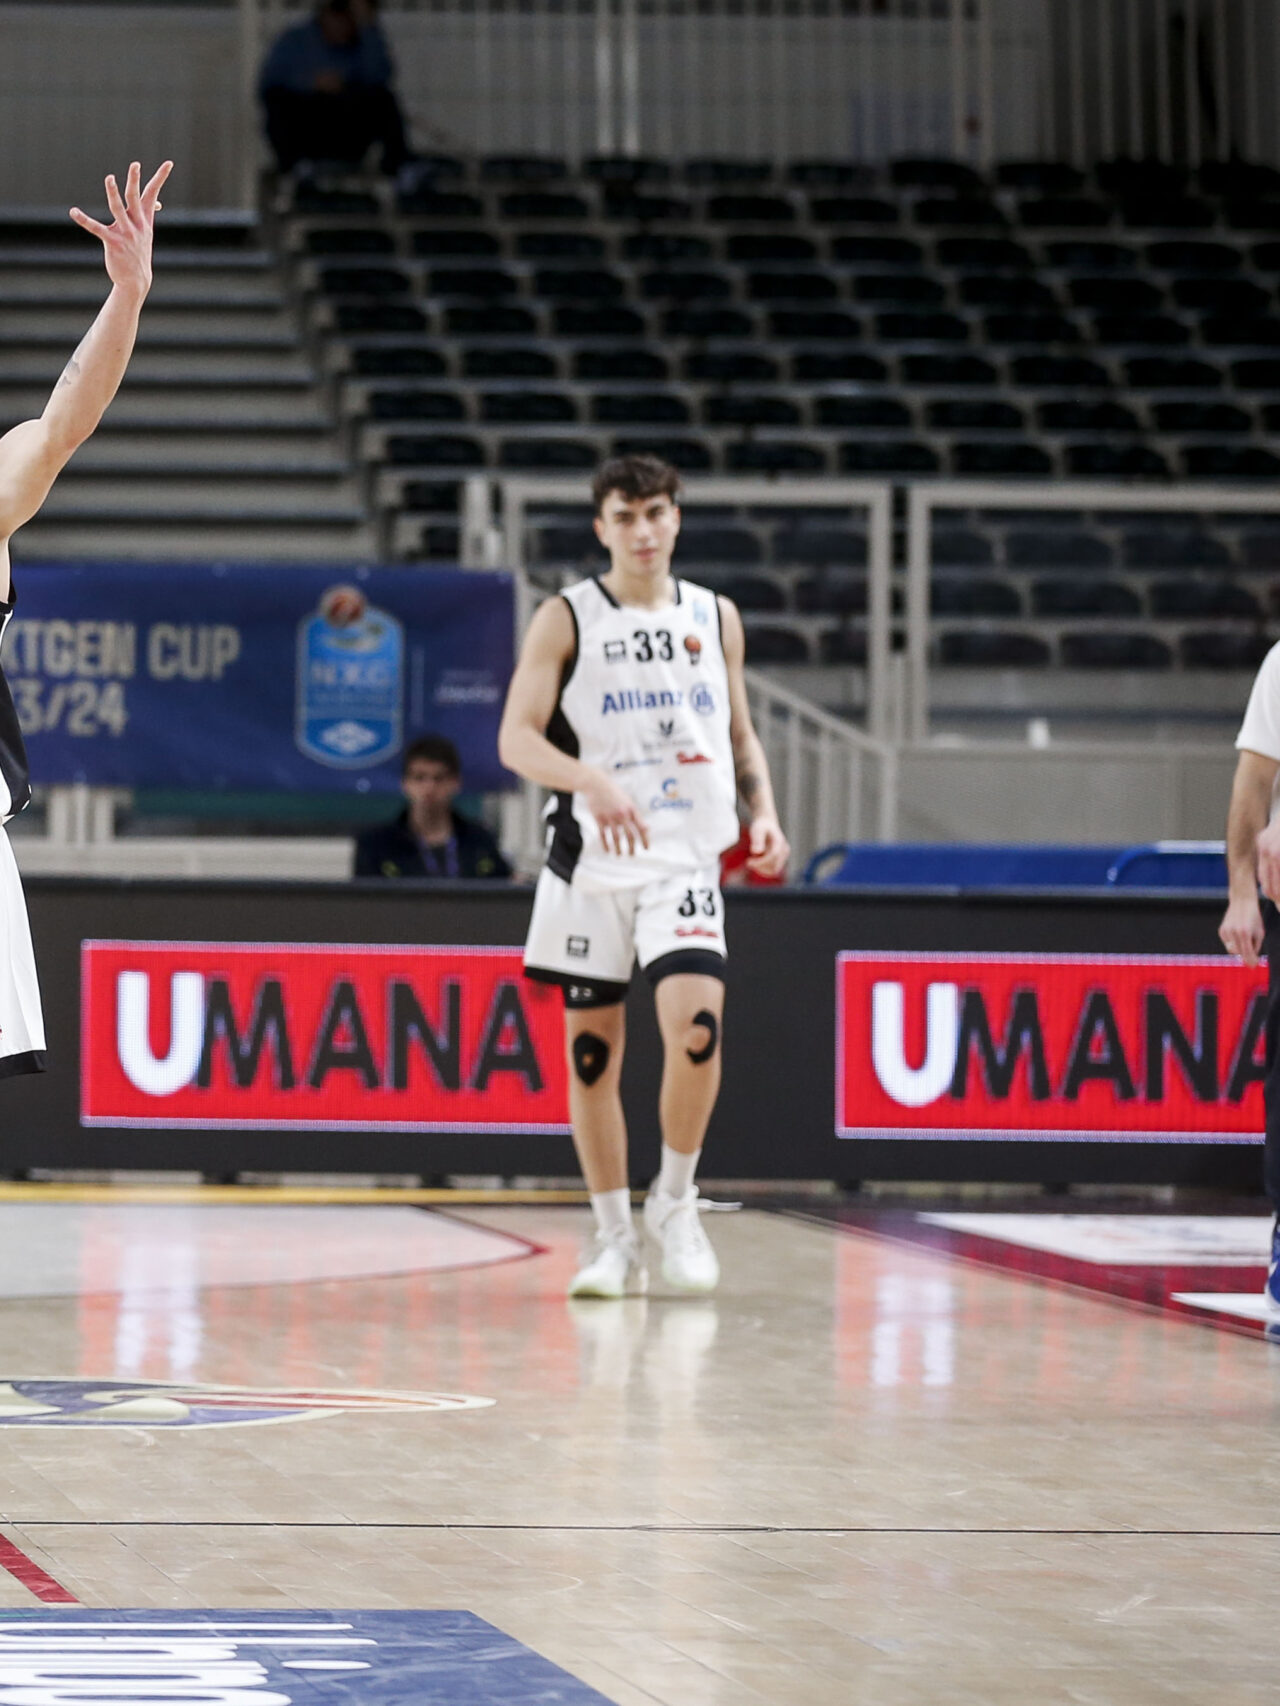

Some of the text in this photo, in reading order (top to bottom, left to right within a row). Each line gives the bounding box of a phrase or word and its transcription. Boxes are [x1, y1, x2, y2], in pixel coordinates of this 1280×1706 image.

[0, 617, 241, 683] XTGEN CUP
[633, 629, 675, 663] 33
[12, 677, 128, 737] 3/24
[678, 889, 716, 918] 33
[117, 970, 545, 1096] UMANA
